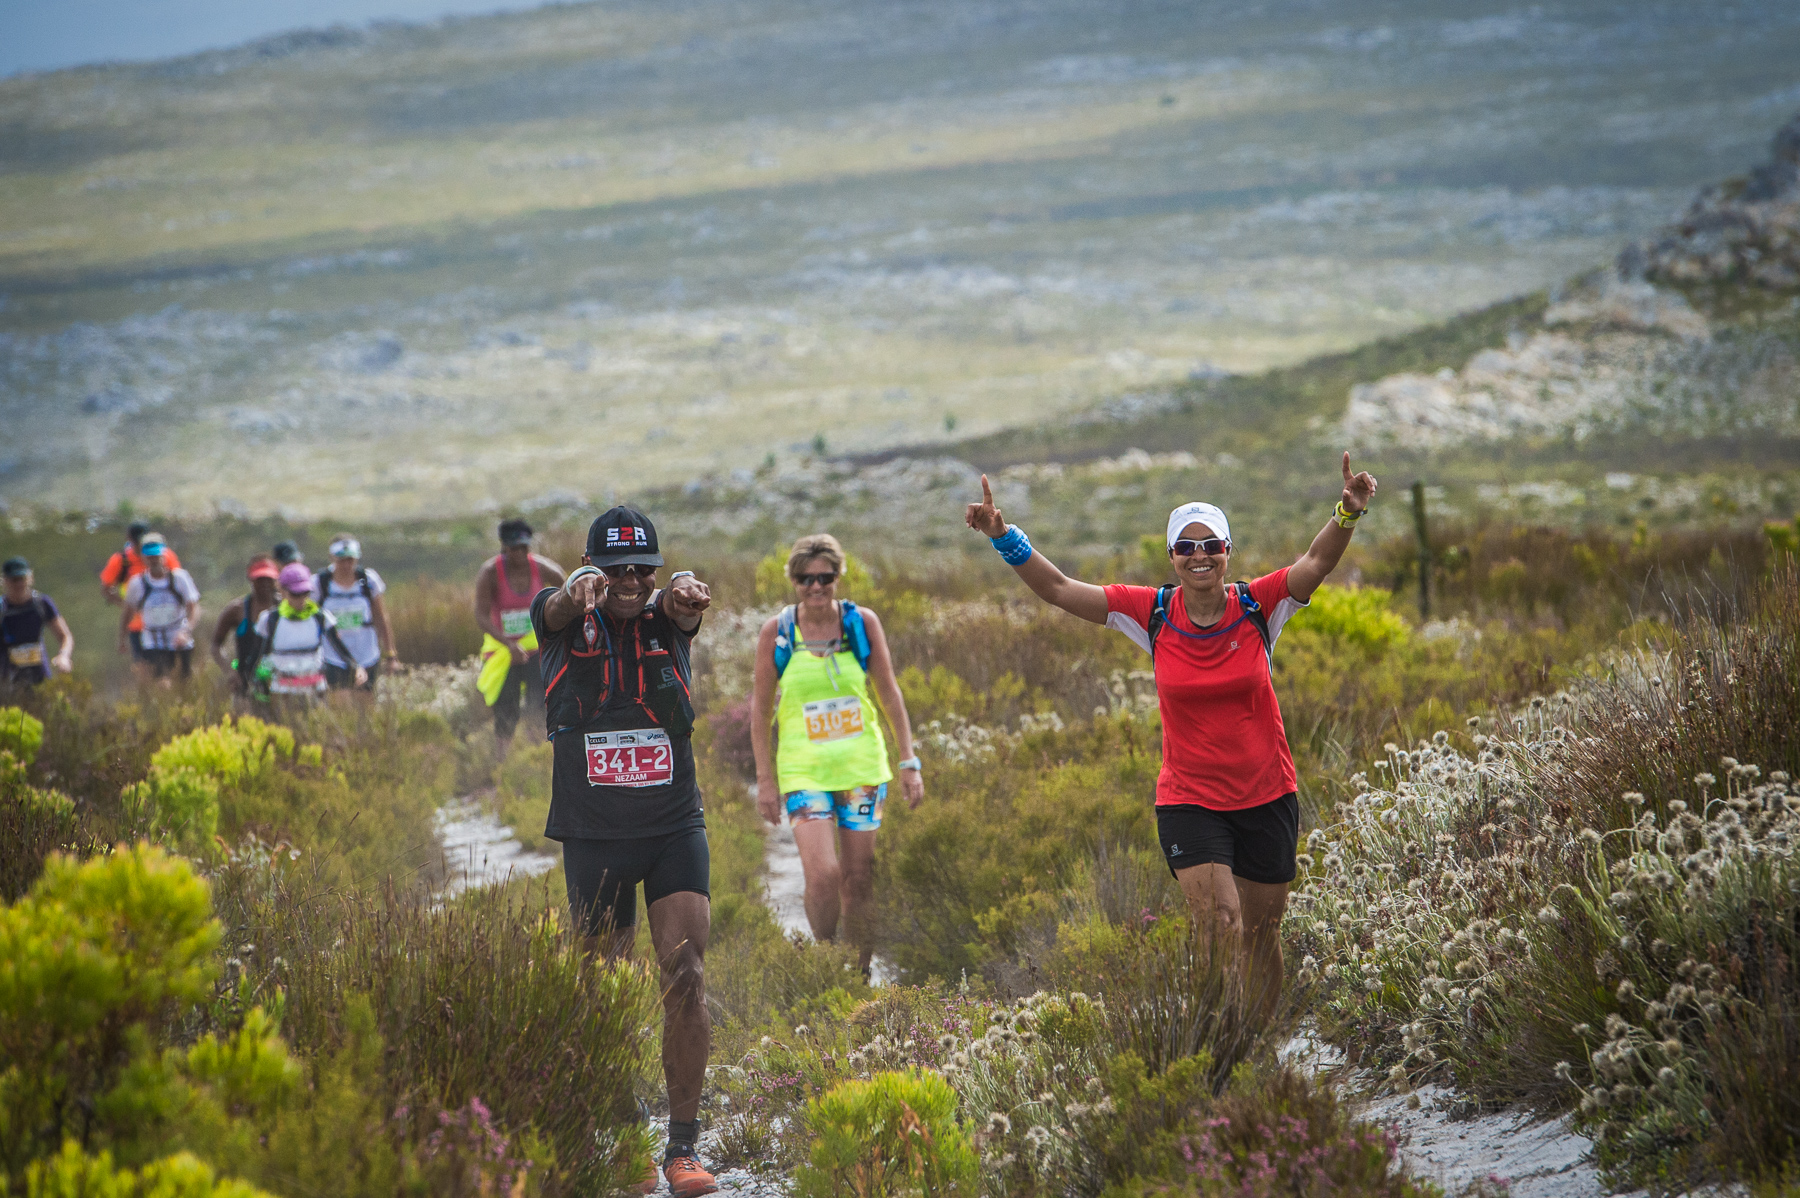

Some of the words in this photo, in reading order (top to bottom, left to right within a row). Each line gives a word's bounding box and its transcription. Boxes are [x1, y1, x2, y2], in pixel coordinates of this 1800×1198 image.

[606, 526, 647, 541] S2R
[809, 707, 861, 733] 510-2
[593, 746, 669, 774] 341-2
[614, 773, 647, 782] NEZAAM
